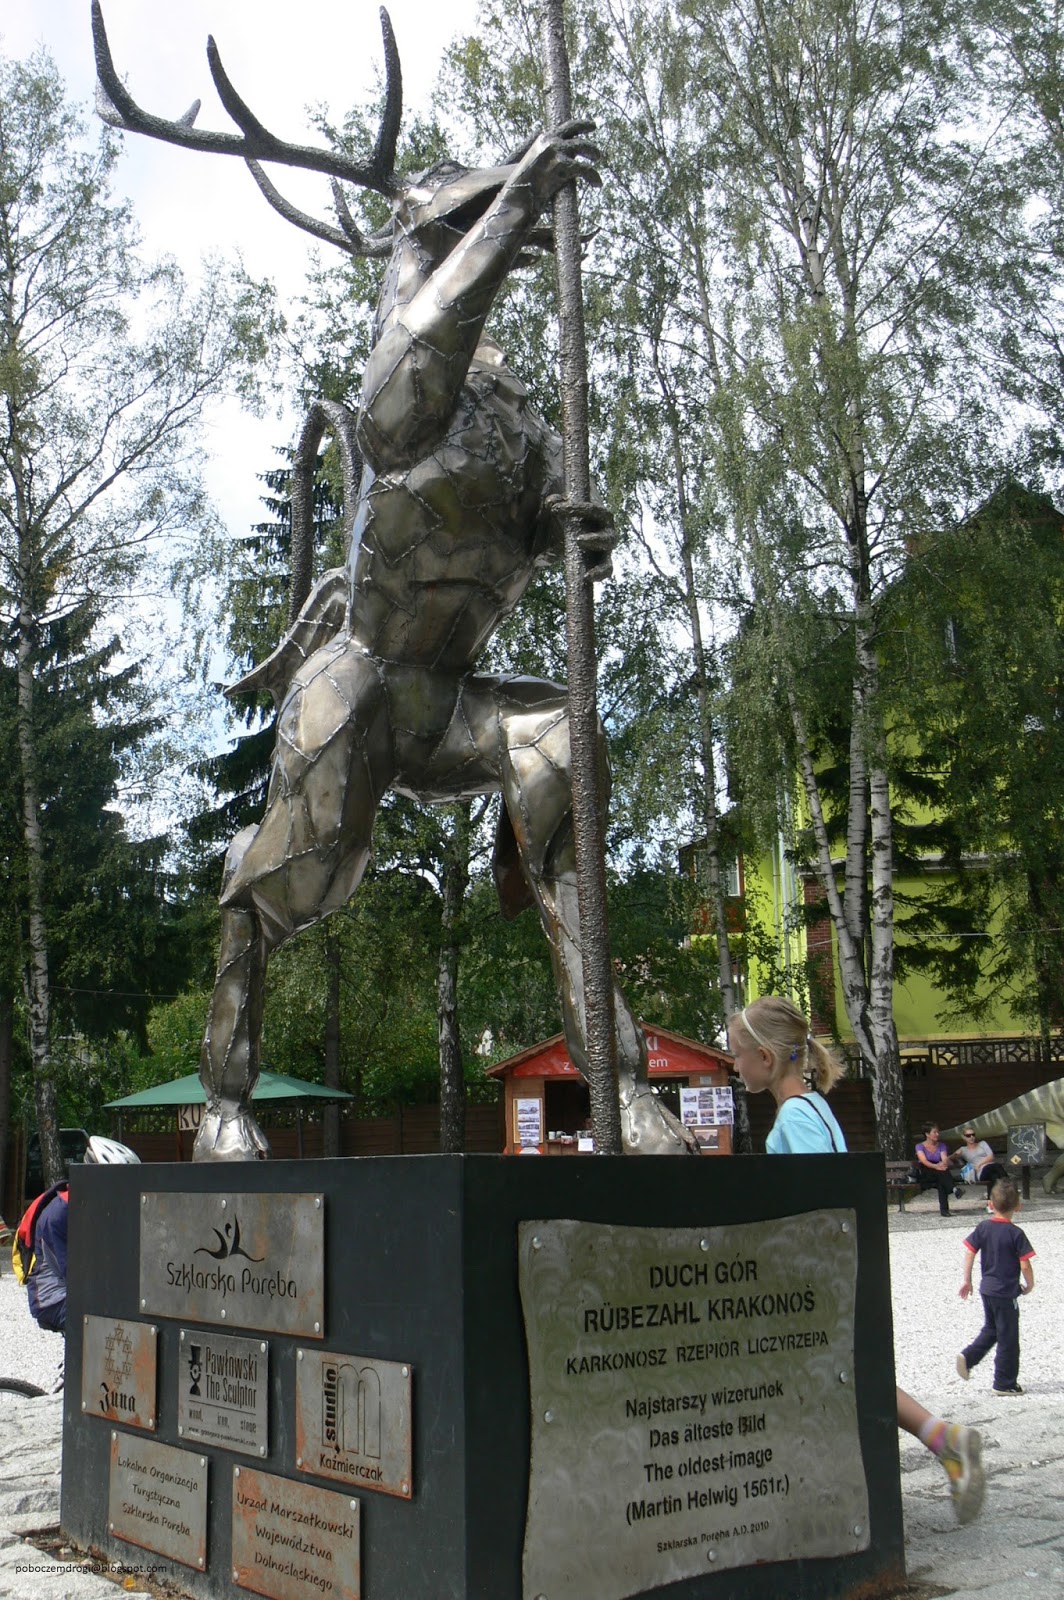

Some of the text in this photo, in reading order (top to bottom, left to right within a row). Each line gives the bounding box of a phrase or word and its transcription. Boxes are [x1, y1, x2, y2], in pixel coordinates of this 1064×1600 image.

[166, 1262, 297, 1300] Szklarska Poręba
[650, 1253, 758, 1289] DUCH GÓR
[584, 1301, 700, 1333] RÜBEZAHL
[205, 1346, 258, 1382] Pawłowski
[566, 1348, 667, 1375] KARKONOSZ
[747, 1330, 829, 1355] LICZYRZEPA
[99, 1381, 137, 1414] Juna
[205, 1374, 257, 1409] The Sculptor
[324, 1367, 337, 1442] studio
[625, 1380, 784, 1420] Najstarszy wizerunek
[649, 1413, 766, 1448] Das älteste Bild
[117, 1455, 199, 1493] Lokalna Organizacja
[319, 1452, 384, 1482] Kaźmierczak
[644, 1447, 773, 1483] The oldest image
[132, 1483, 181, 1509] Turystyczna
[625, 1495, 682, 1526] (Martin
[687, 1485, 738, 1510] Helwig
[122, 1502, 191, 1537] Szklarska Poręba
[236, 1491, 355, 1539] Urząd Marszałkowski
[255, 1524, 333, 1562] Województwa
[656, 1536, 698, 1553] Szklarska
[750, 1520, 770, 1534] 2010
[254, 1551, 333, 1593] Dolnośląskiego
